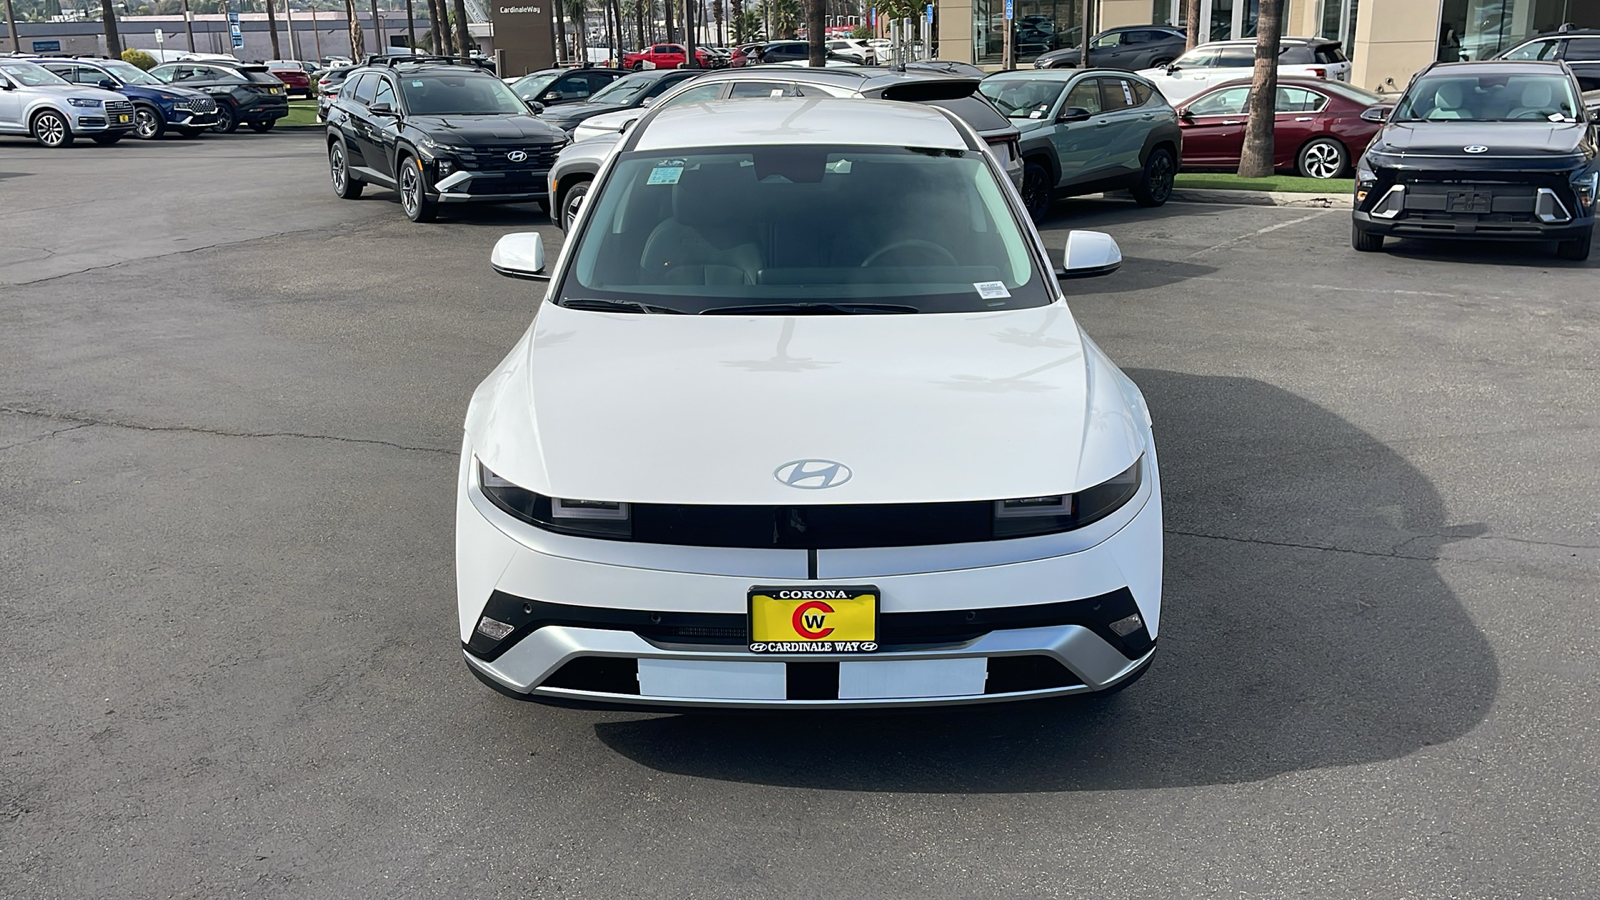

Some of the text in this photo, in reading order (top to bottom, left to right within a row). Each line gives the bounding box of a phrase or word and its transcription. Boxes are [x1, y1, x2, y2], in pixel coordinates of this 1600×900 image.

[499, 6, 541, 14] CardinaleWay
[779, 590, 848, 599] CORONA
[767, 642, 860, 652] CARDINALE WAY
